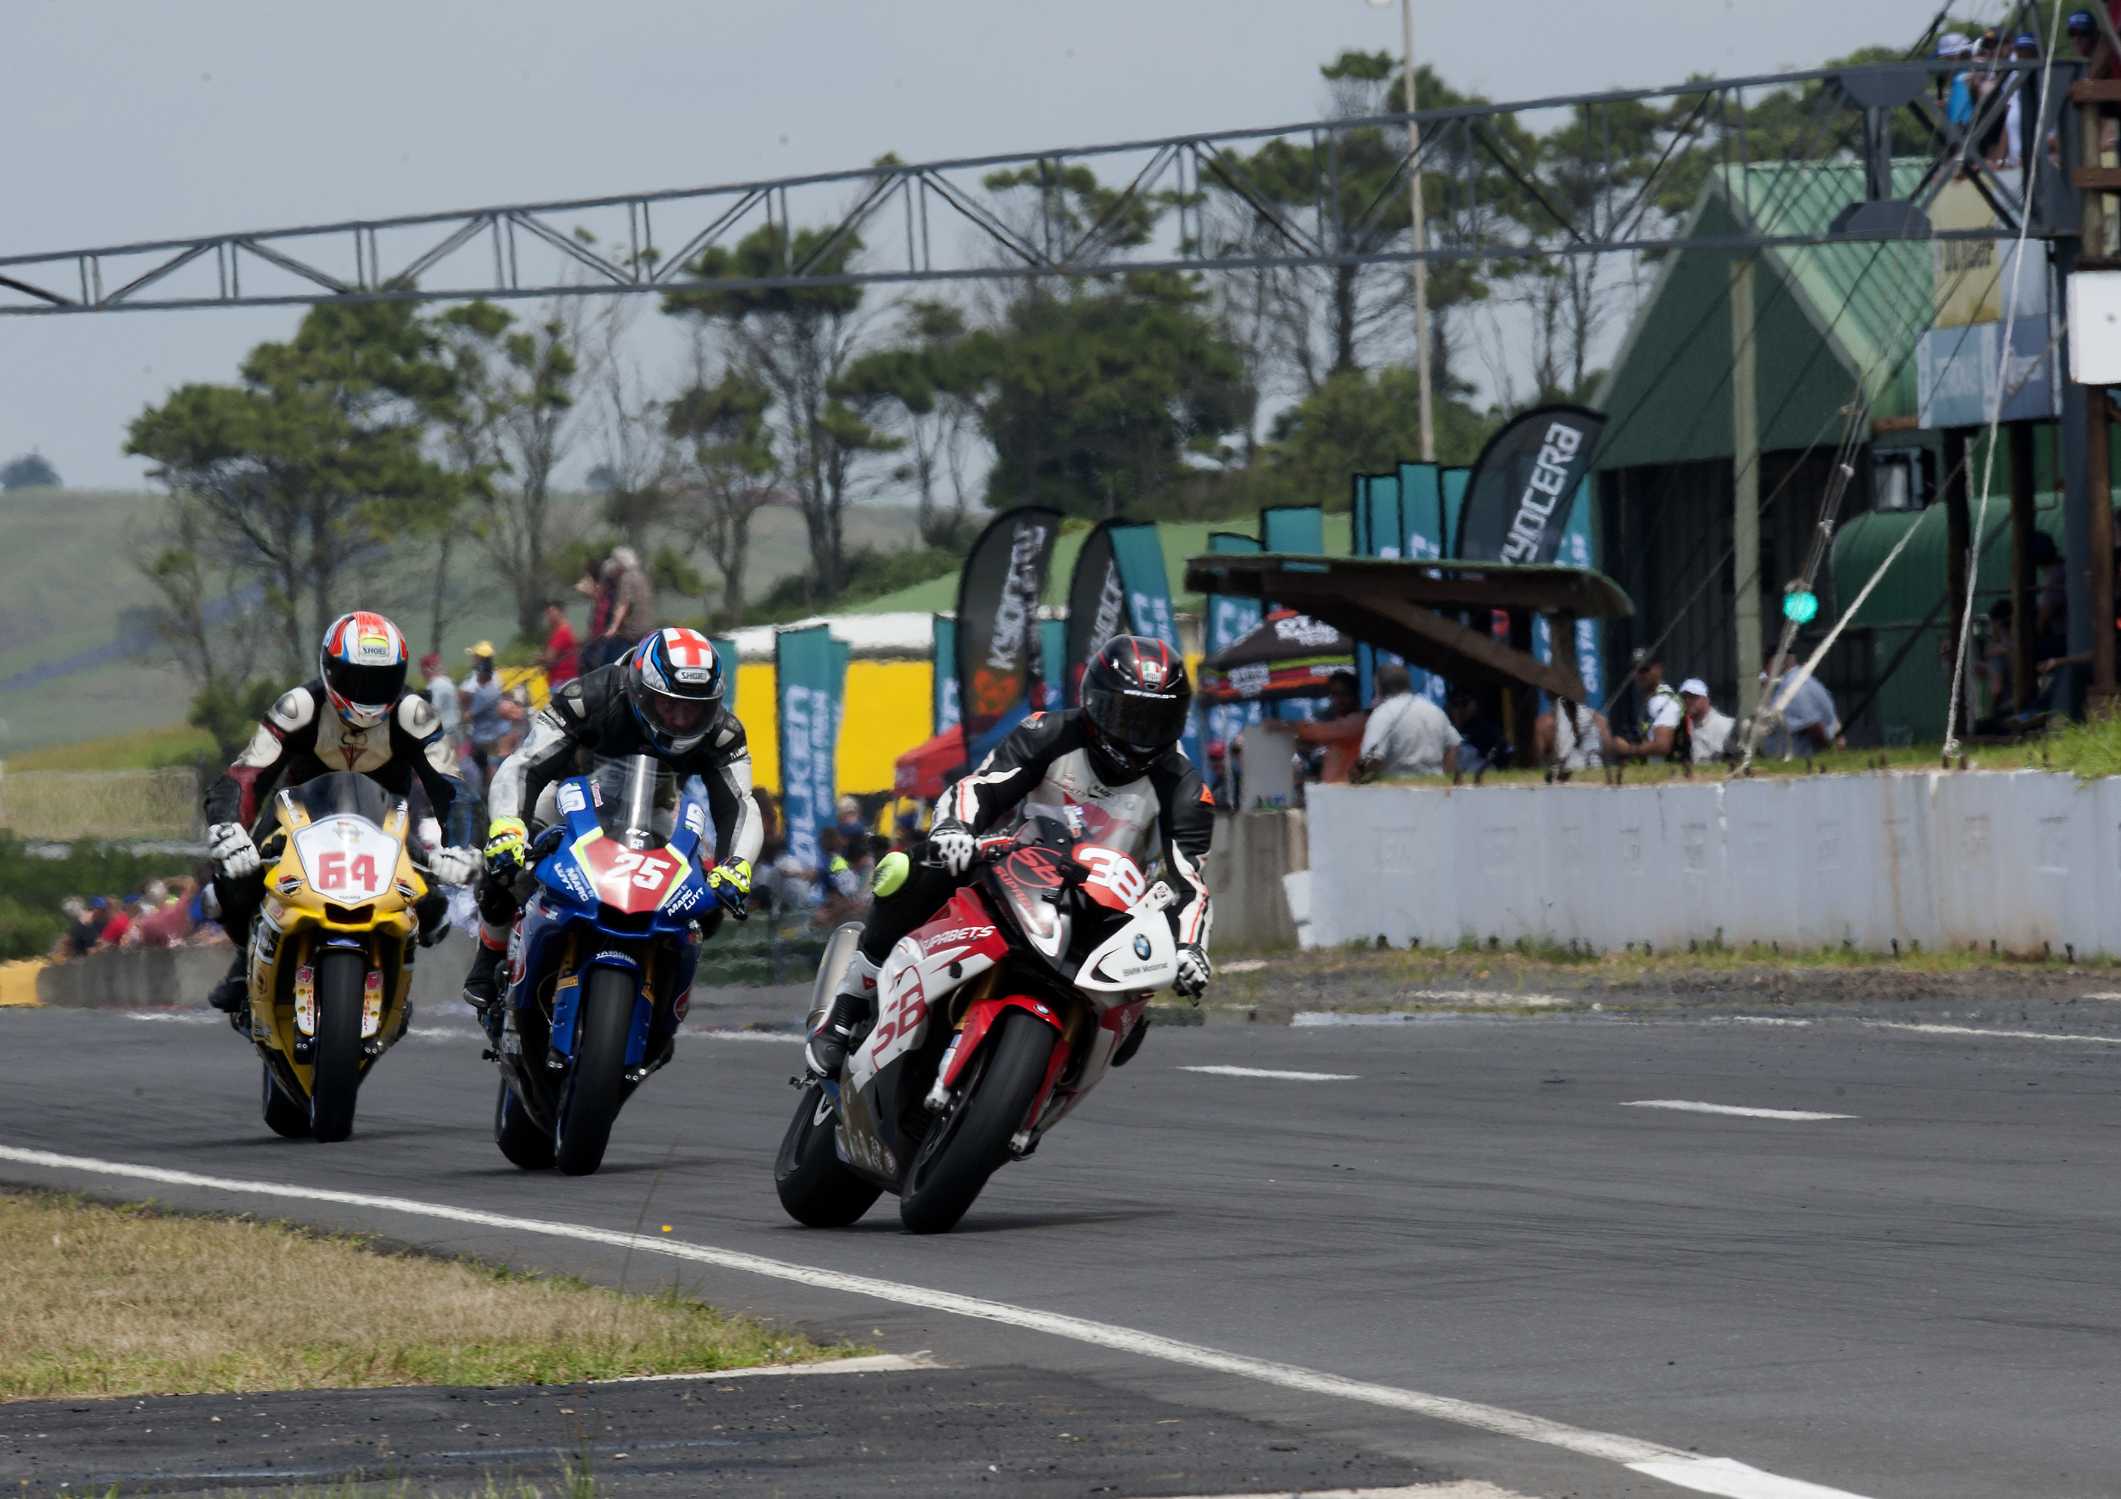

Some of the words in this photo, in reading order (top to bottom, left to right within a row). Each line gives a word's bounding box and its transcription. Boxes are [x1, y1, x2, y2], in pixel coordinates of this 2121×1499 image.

[1499, 421, 1584, 564] YOCERA
[1577, 618, 1595, 651] TH
[680, 670, 708, 680] SHOEI
[785, 686, 817, 867] ALKEN
[319, 852, 388, 892] 64
[604, 851, 671, 890] 25
[1079, 848, 1145, 907] 38
[684, 887, 704, 910] LUYT
[922, 925, 997, 948] UPABETS
